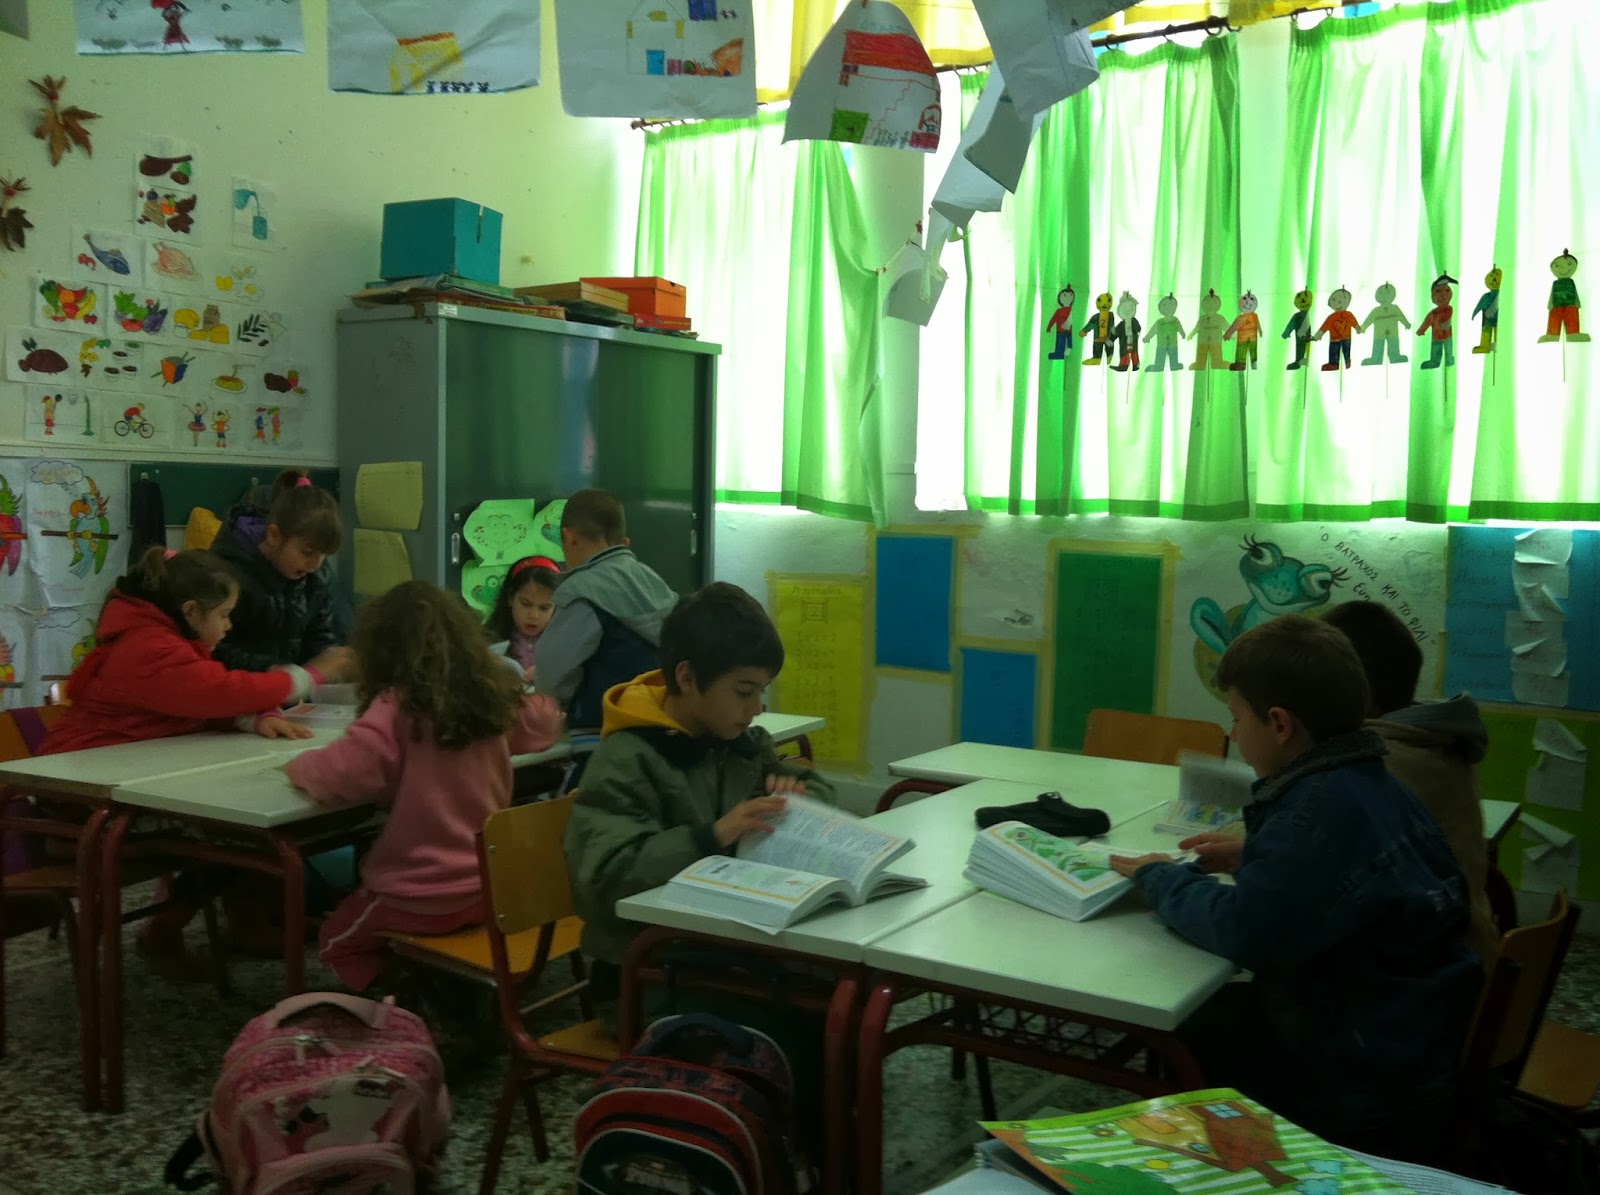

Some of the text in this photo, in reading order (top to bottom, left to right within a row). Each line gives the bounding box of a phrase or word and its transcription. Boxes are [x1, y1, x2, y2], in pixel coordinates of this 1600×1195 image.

[1334, 541, 1379, 581] ΒΑΤΡΑΧΟΣ
[1381, 584, 1400, 600] ΚΑΙ
[1398, 600, 1411, 617] ΤΟ
